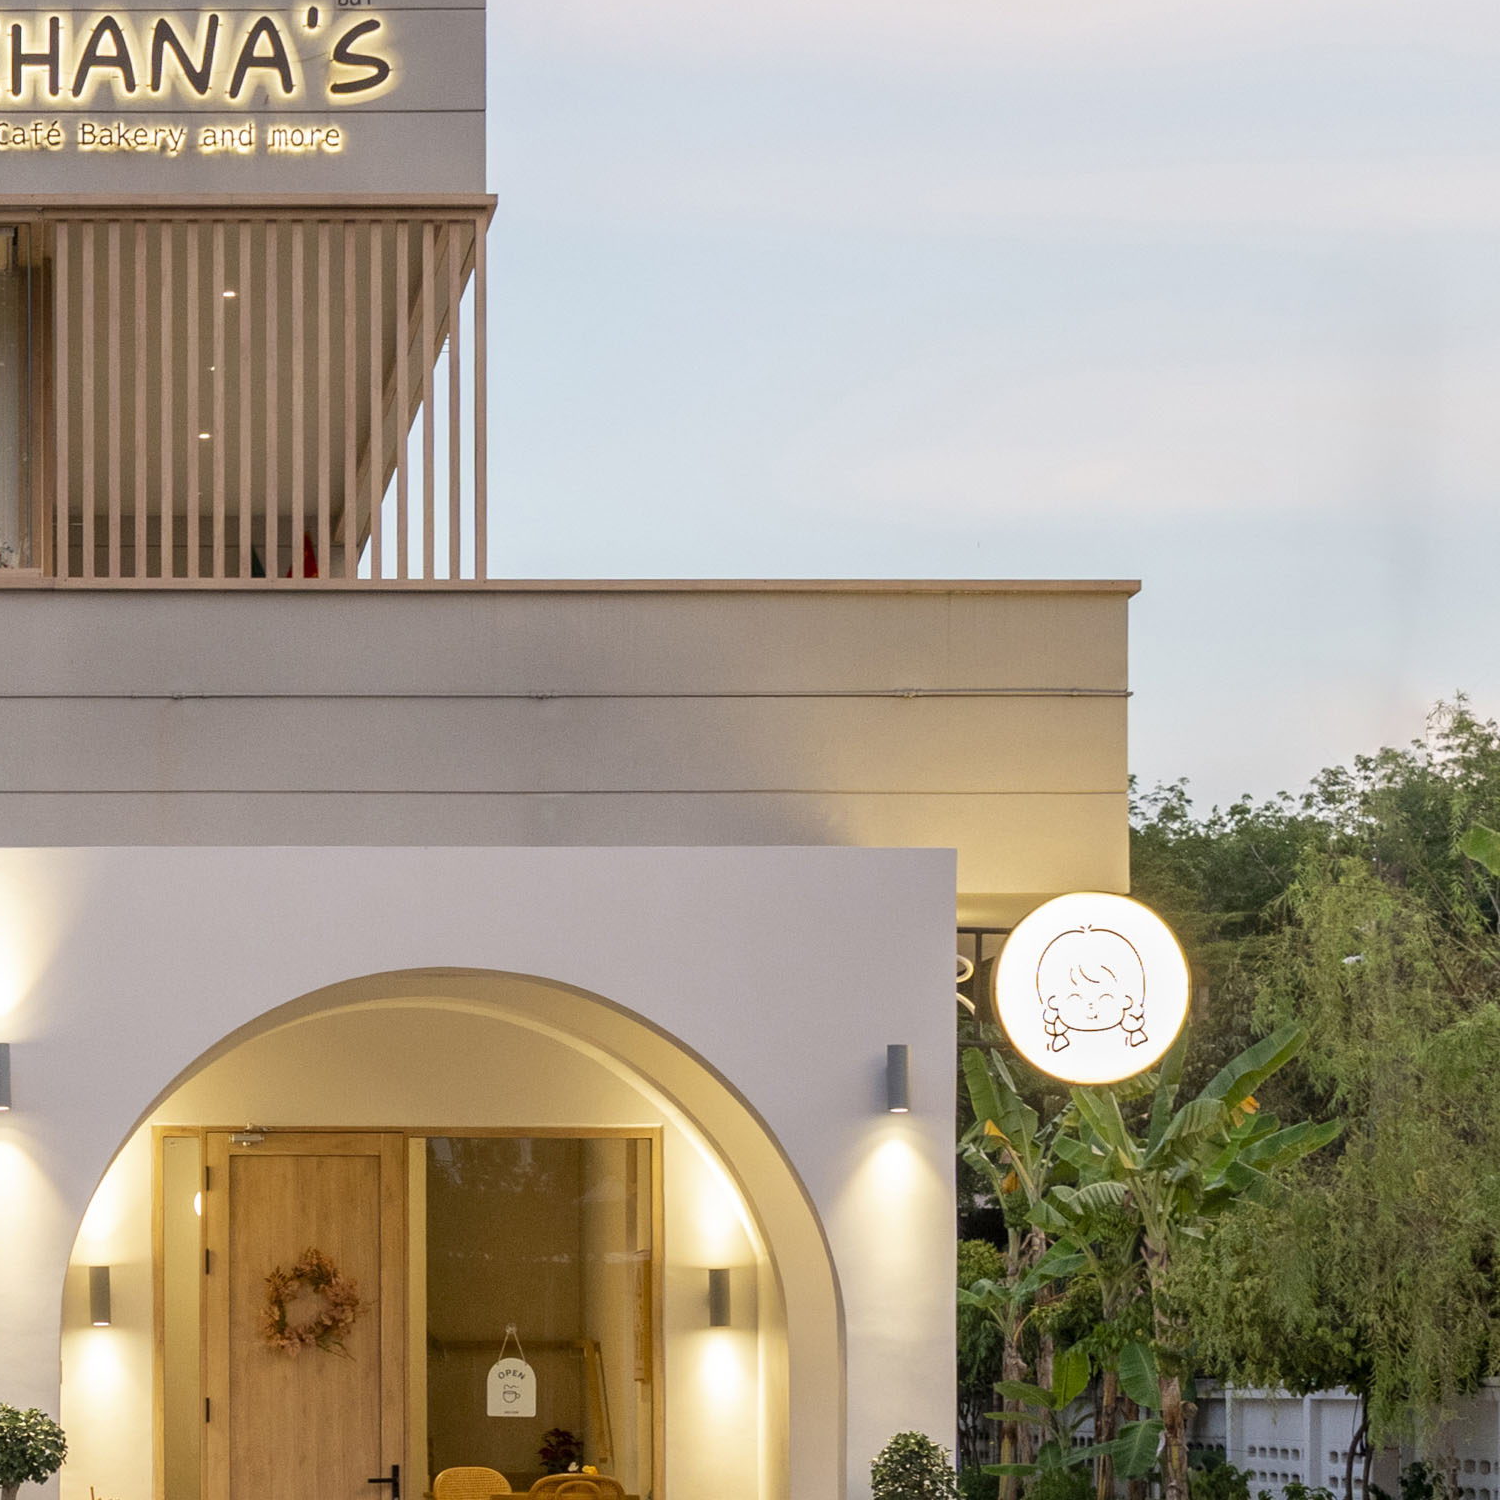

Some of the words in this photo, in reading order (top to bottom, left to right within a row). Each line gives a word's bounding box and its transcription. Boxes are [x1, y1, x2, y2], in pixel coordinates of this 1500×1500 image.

[78, 122, 185, 153] Bakery
[202, 123, 254, 147] and
[269, 126, 340, 147] more
[498, 1369, 526, 1380] OPEN
